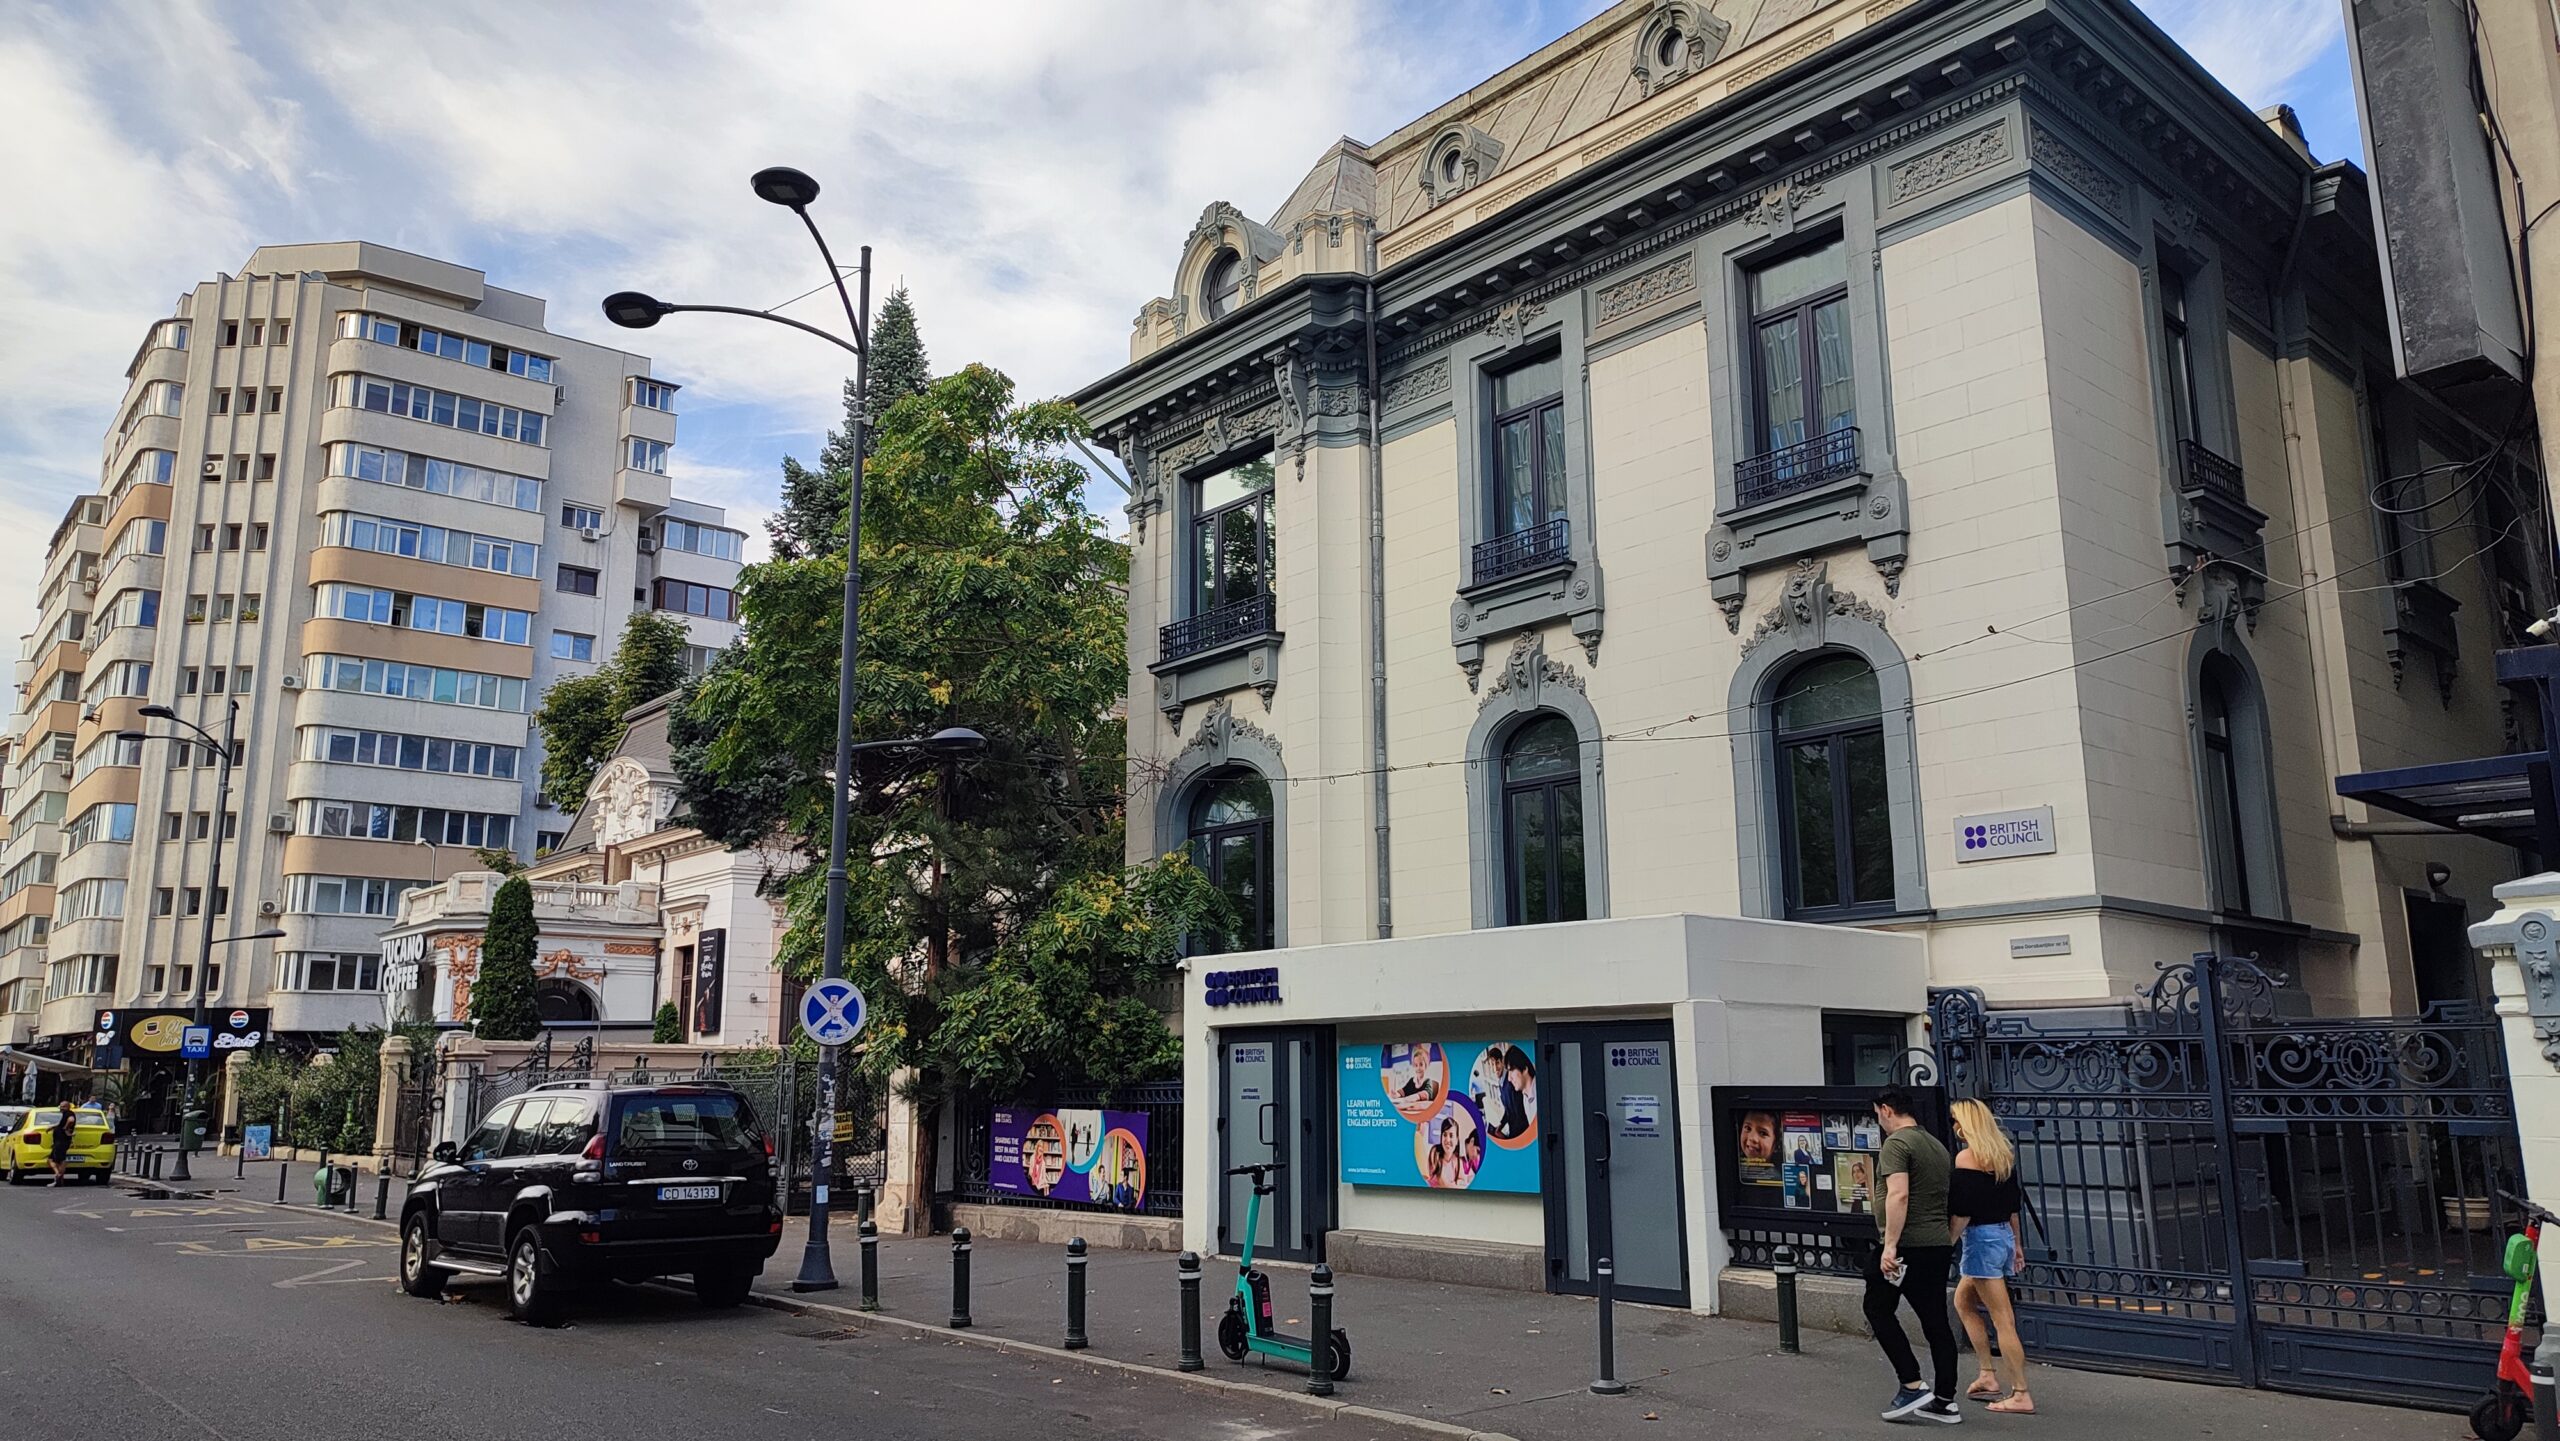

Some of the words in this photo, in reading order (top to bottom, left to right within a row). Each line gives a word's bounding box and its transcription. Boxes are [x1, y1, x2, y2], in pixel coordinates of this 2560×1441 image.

[1989, 819, 2039, 835] BRITISH
[1990, 831, 2044, 846] COUNCIL
[382, 933, 424, 966] TUCANO
[383, 964, 419, 993] COFFEE
[1228, 967, 1279, 988] BRITISH
[1228, 985, 1283, 1004] COUNCIL
[1628, 1048, 1659, 1057] BRITISH
[1628, 1057, 1661, 1066] COUNCIL
[1347, 1109, 1357, 1117] THE
[1359, 1109, 1384, 1117] WORLD'S
[1347, 1118, 1371, 1127] ENGLISH
[1372, 1119, 1398, 1127] EXPERTS
[995, 1145, 1004, 1153] BEST
[664, 1188, 680, 1200] CD
[683, 1187, 716, 1199] 143133
